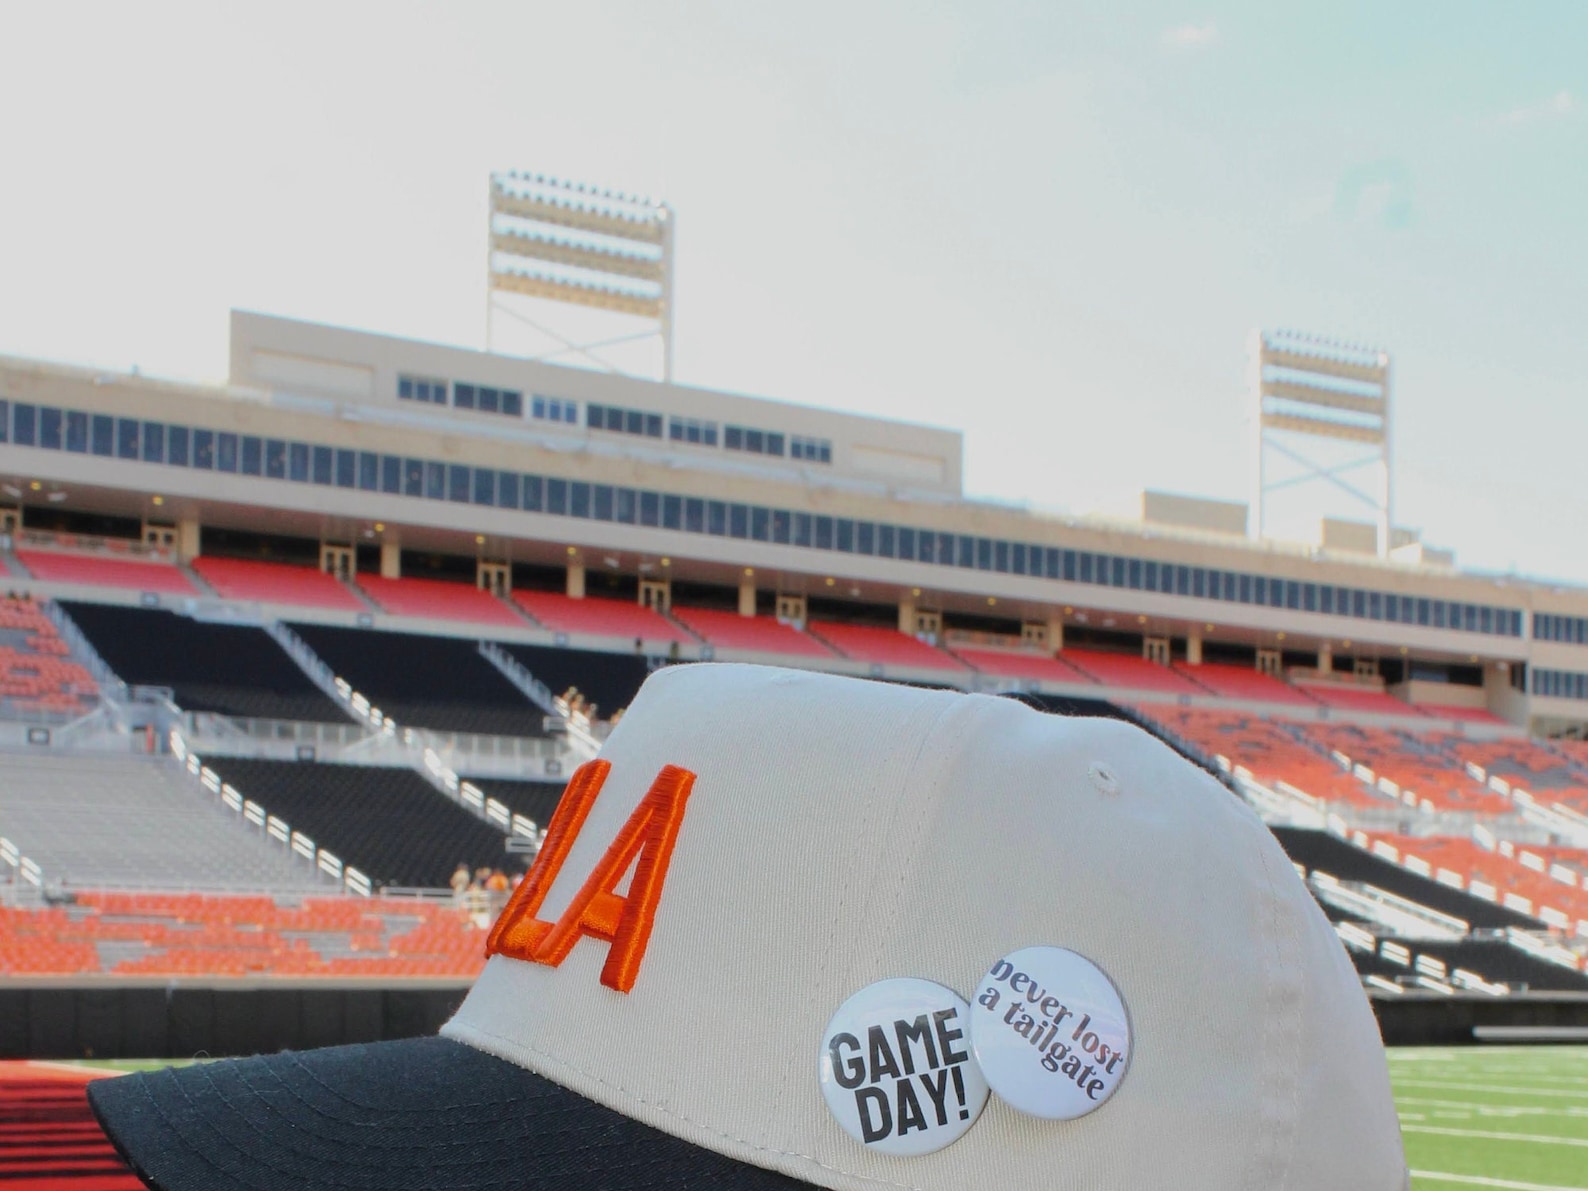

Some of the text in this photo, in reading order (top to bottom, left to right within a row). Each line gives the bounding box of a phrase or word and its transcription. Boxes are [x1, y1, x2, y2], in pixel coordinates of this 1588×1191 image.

[828, 1007, 968, 1089] GAME
[978, 985, 1105, 1100] a tailgate
[989, 957, 1123, 1075] never lost
[855, 1065, 969, 1144] DAY!
